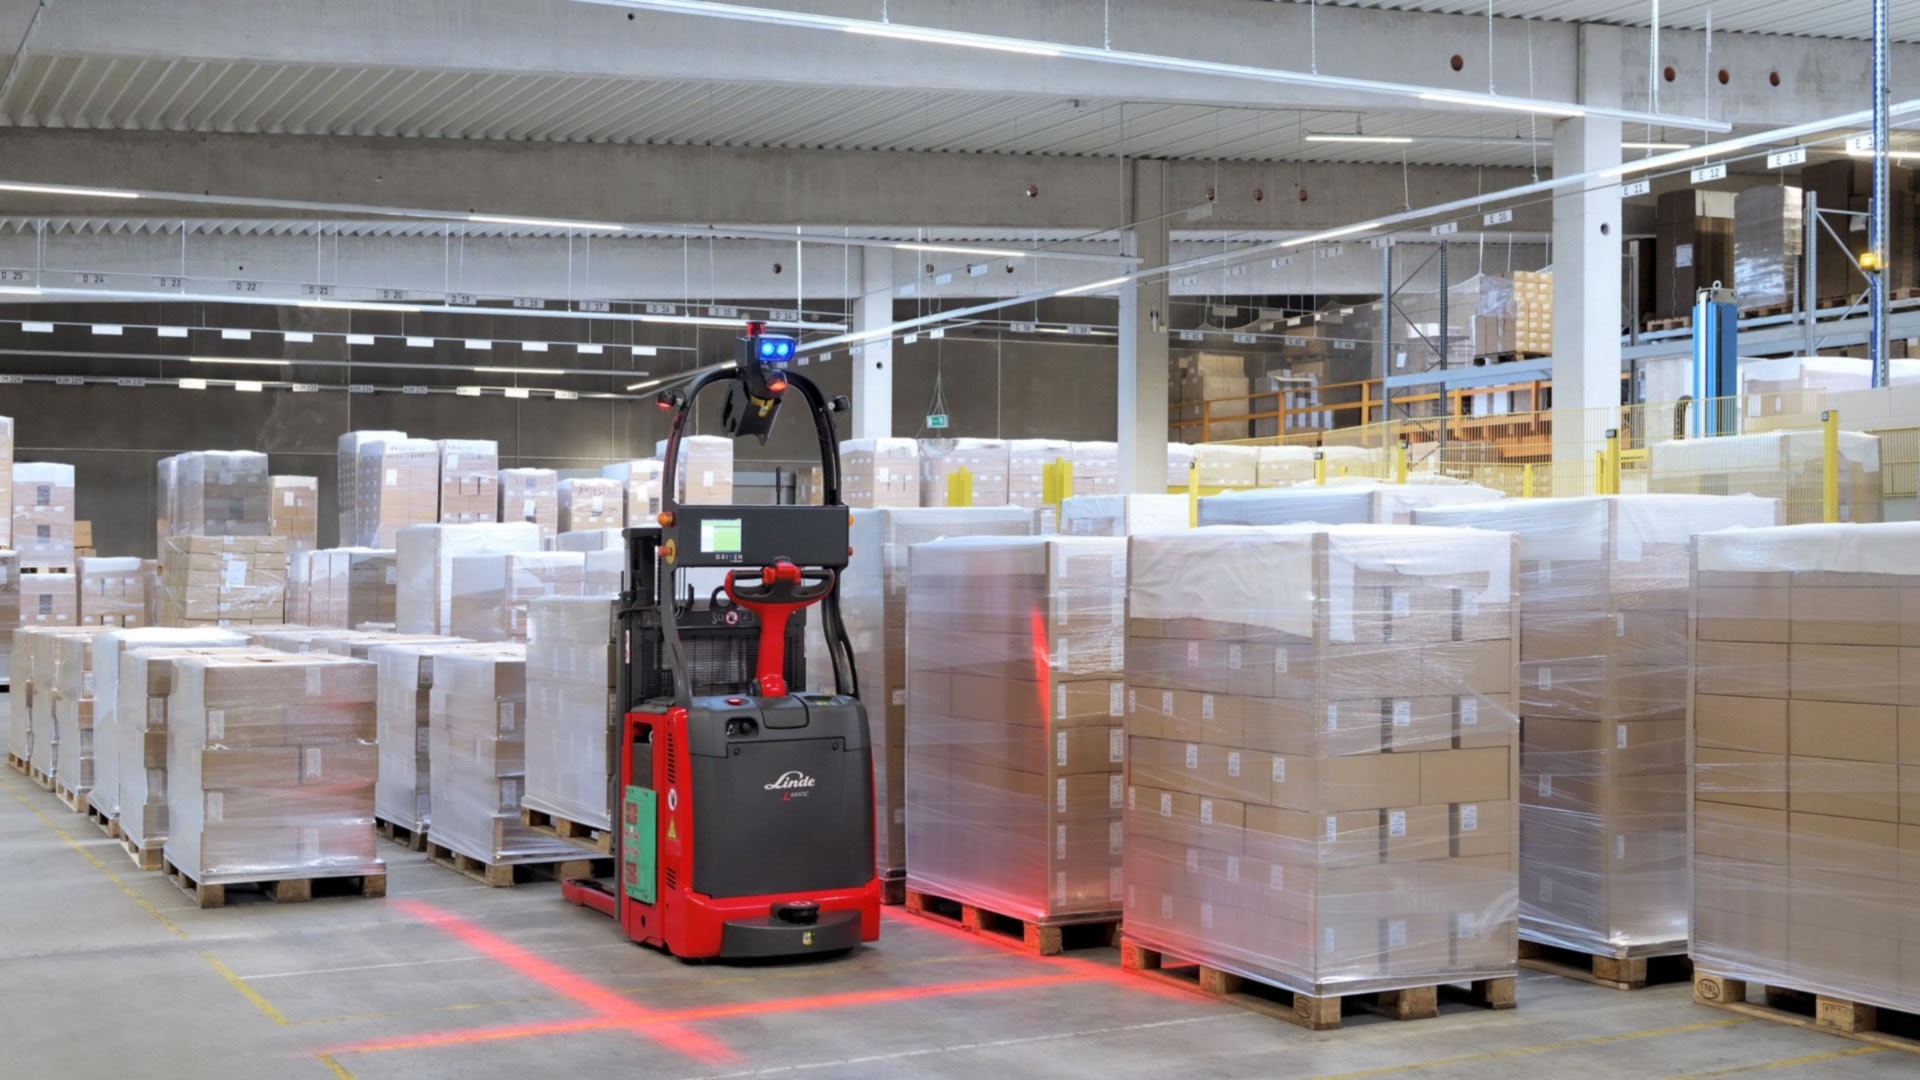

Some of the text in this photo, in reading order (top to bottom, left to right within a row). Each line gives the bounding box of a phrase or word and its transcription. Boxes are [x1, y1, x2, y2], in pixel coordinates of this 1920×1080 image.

[1776, 153, 1799, 166] E 13
[1699, 168, 1720, 181] E 12
[1623, 184, 1644, 196] E 11
[12, 271, 23, 280] 25
[94, 274, 104, 283] 24
[171, 279, 181, 287] 23
[247, 282, 256, 291] 22
[319, 286, 328, 294] 21
[394, 290, 403, 299] 20
[764, 770, 816, 790] Linde
[1699, 981, 1718, 997] EPAL
